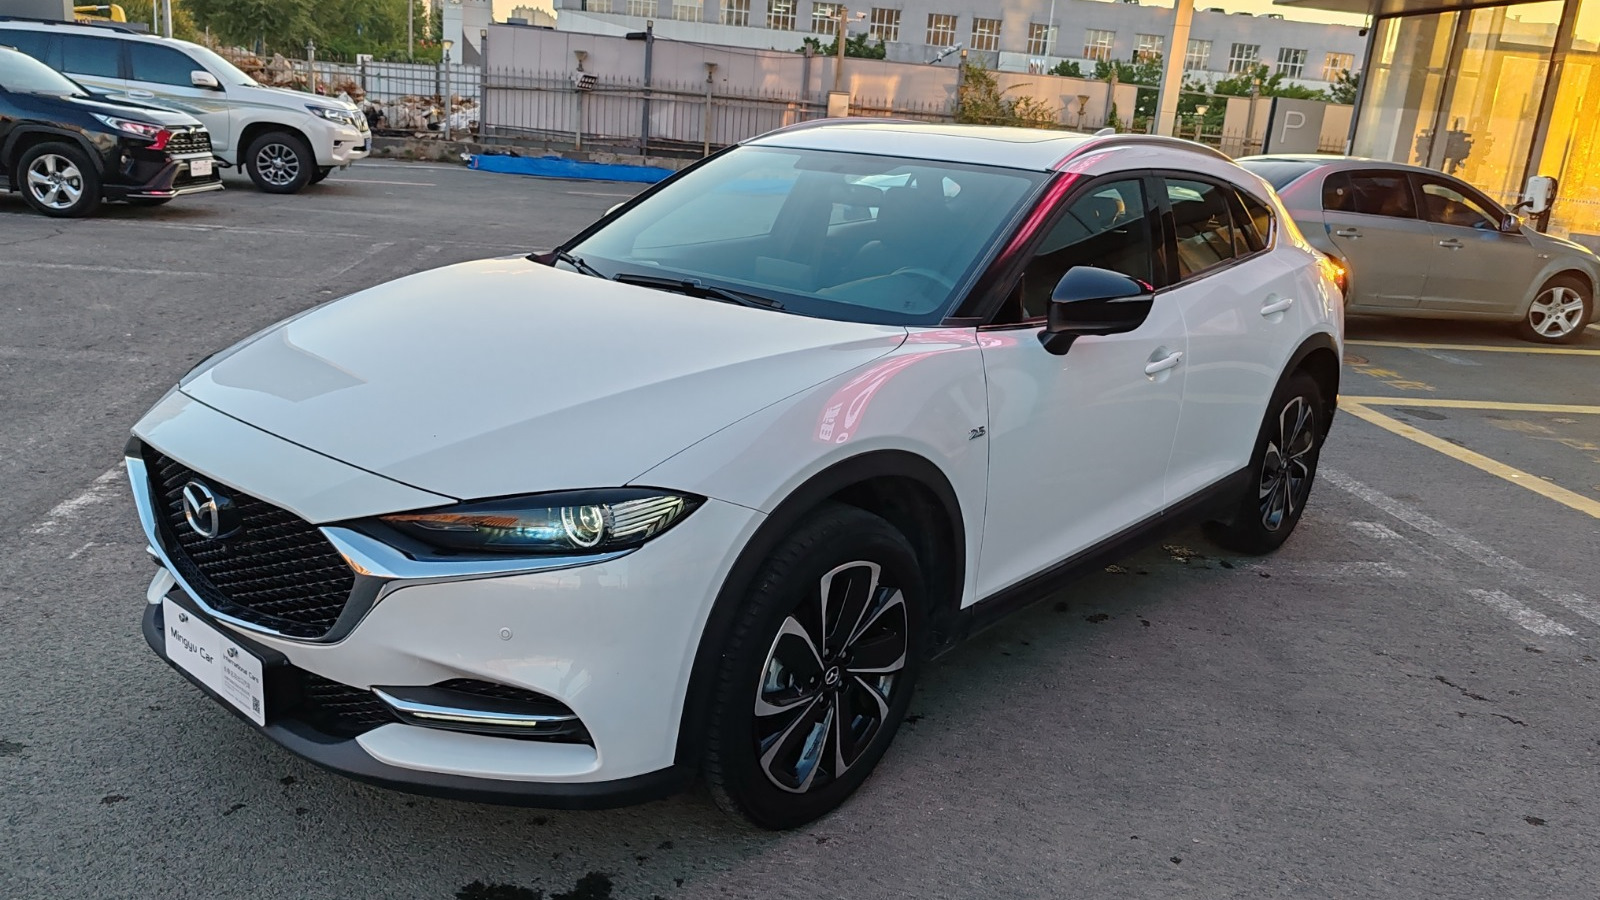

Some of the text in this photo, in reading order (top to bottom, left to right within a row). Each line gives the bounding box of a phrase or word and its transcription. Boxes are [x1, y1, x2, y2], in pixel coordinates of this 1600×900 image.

[1280, 110, 1306, 144] P
[170, 626, 214, 665] Mingyu Car
